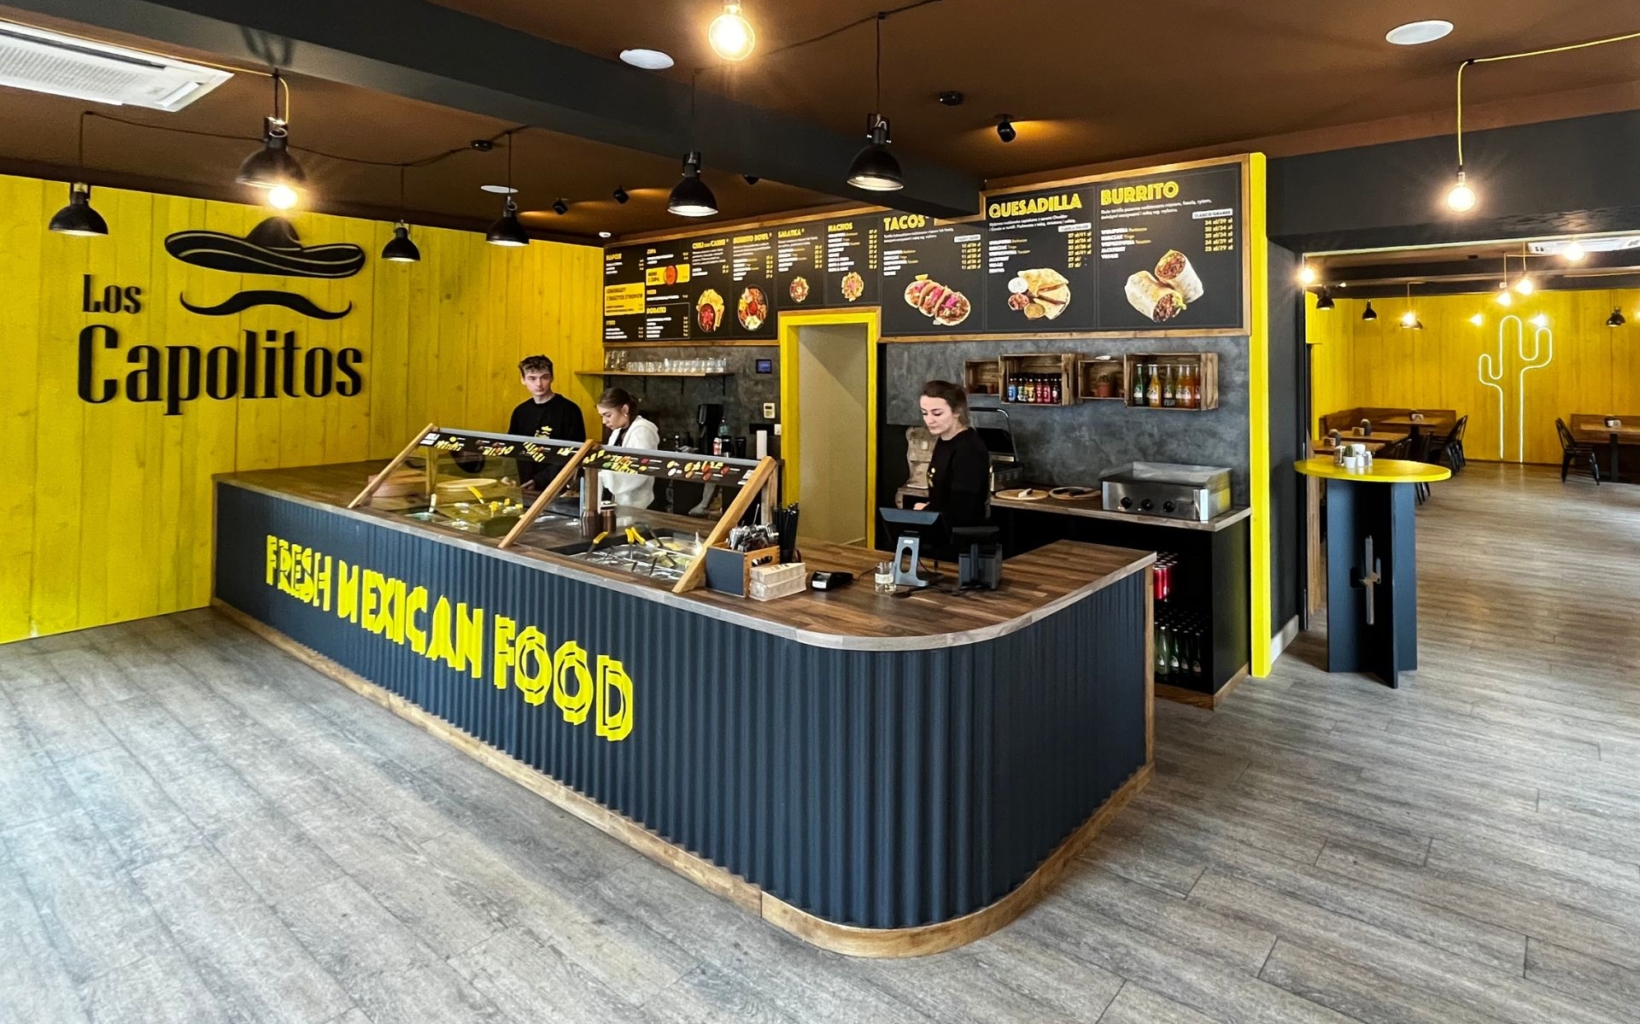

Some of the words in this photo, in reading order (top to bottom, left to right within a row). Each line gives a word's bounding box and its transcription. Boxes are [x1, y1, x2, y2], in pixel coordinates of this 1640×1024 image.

[988, 193, 1082, 218] QUESADILLA
[1100, 181, 1179, 206] BURRITO
[883, 214, 926, 231] TACOS
[82, 274, 142, 314] Los
[78, 324, 362, 416] Capolitos
[266, 534, 332, 611] FRESH
[338, 559, 484, 679] MEXICAN
[494, 614, 633, 742] FOOD
